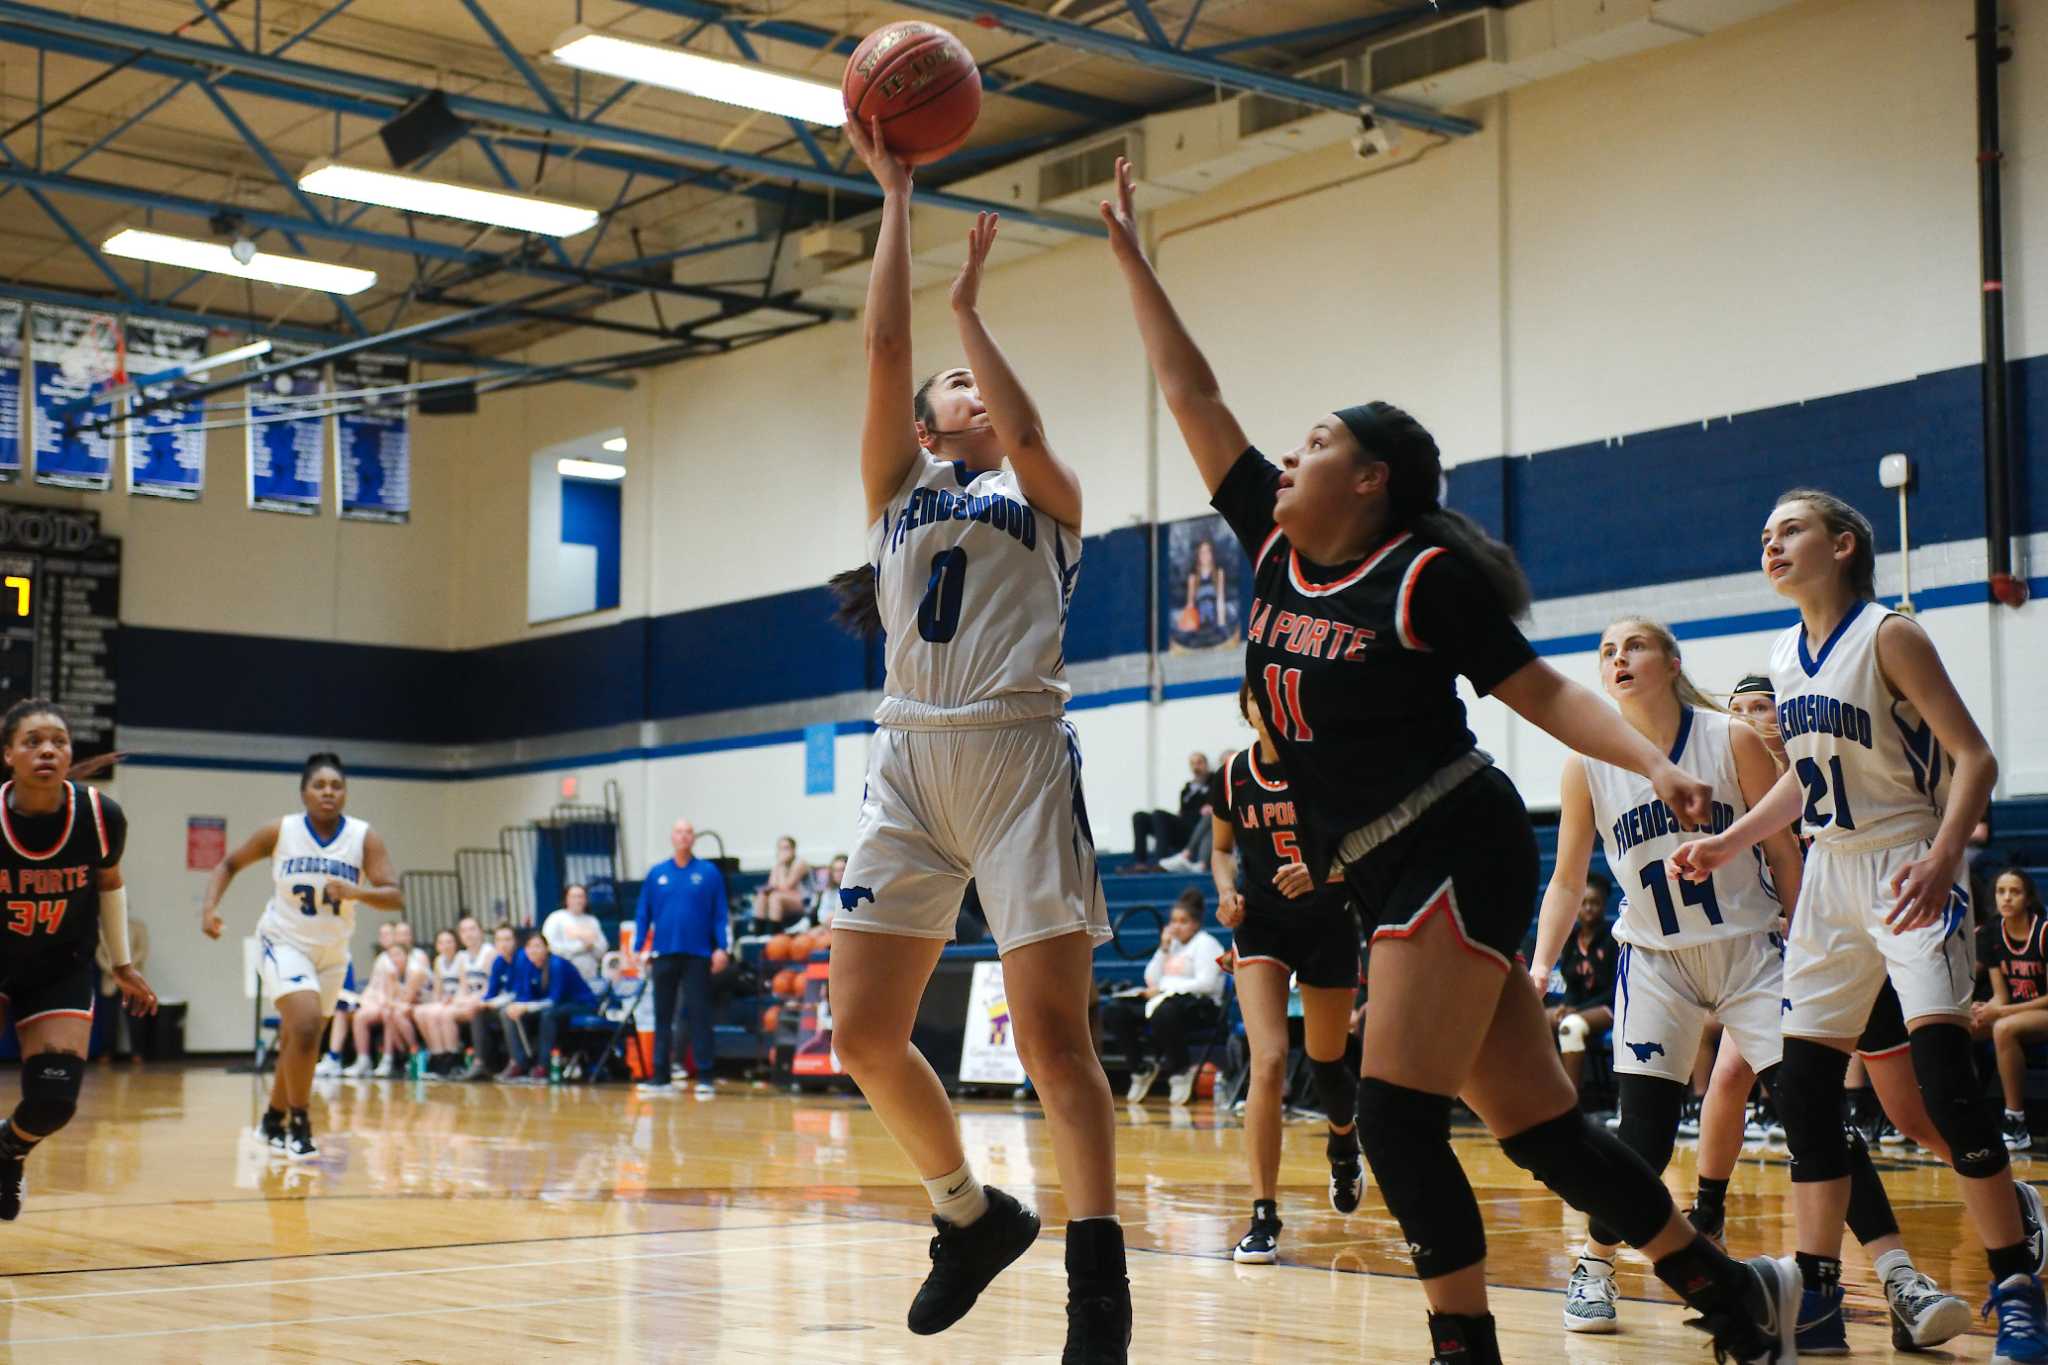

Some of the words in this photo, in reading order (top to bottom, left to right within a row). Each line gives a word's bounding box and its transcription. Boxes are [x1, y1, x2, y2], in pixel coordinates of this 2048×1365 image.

[4, 576, 31, 617] 7
[918, 546, 967, 643] 0
[1268, 609, 1376, 662] PORTE
[1263, 663, 1313, 741] 11
[1262, 801, 1298, 827] POR
[1796, 755, 1855, 830] 21
[1272, 831, 1302, 864] 5
[0, 869, 12, 894] A
[19, 865, 89, 894] PORTE
[1639, 859, 1724, 936] 14
[7, 899, 68, 936] 34
